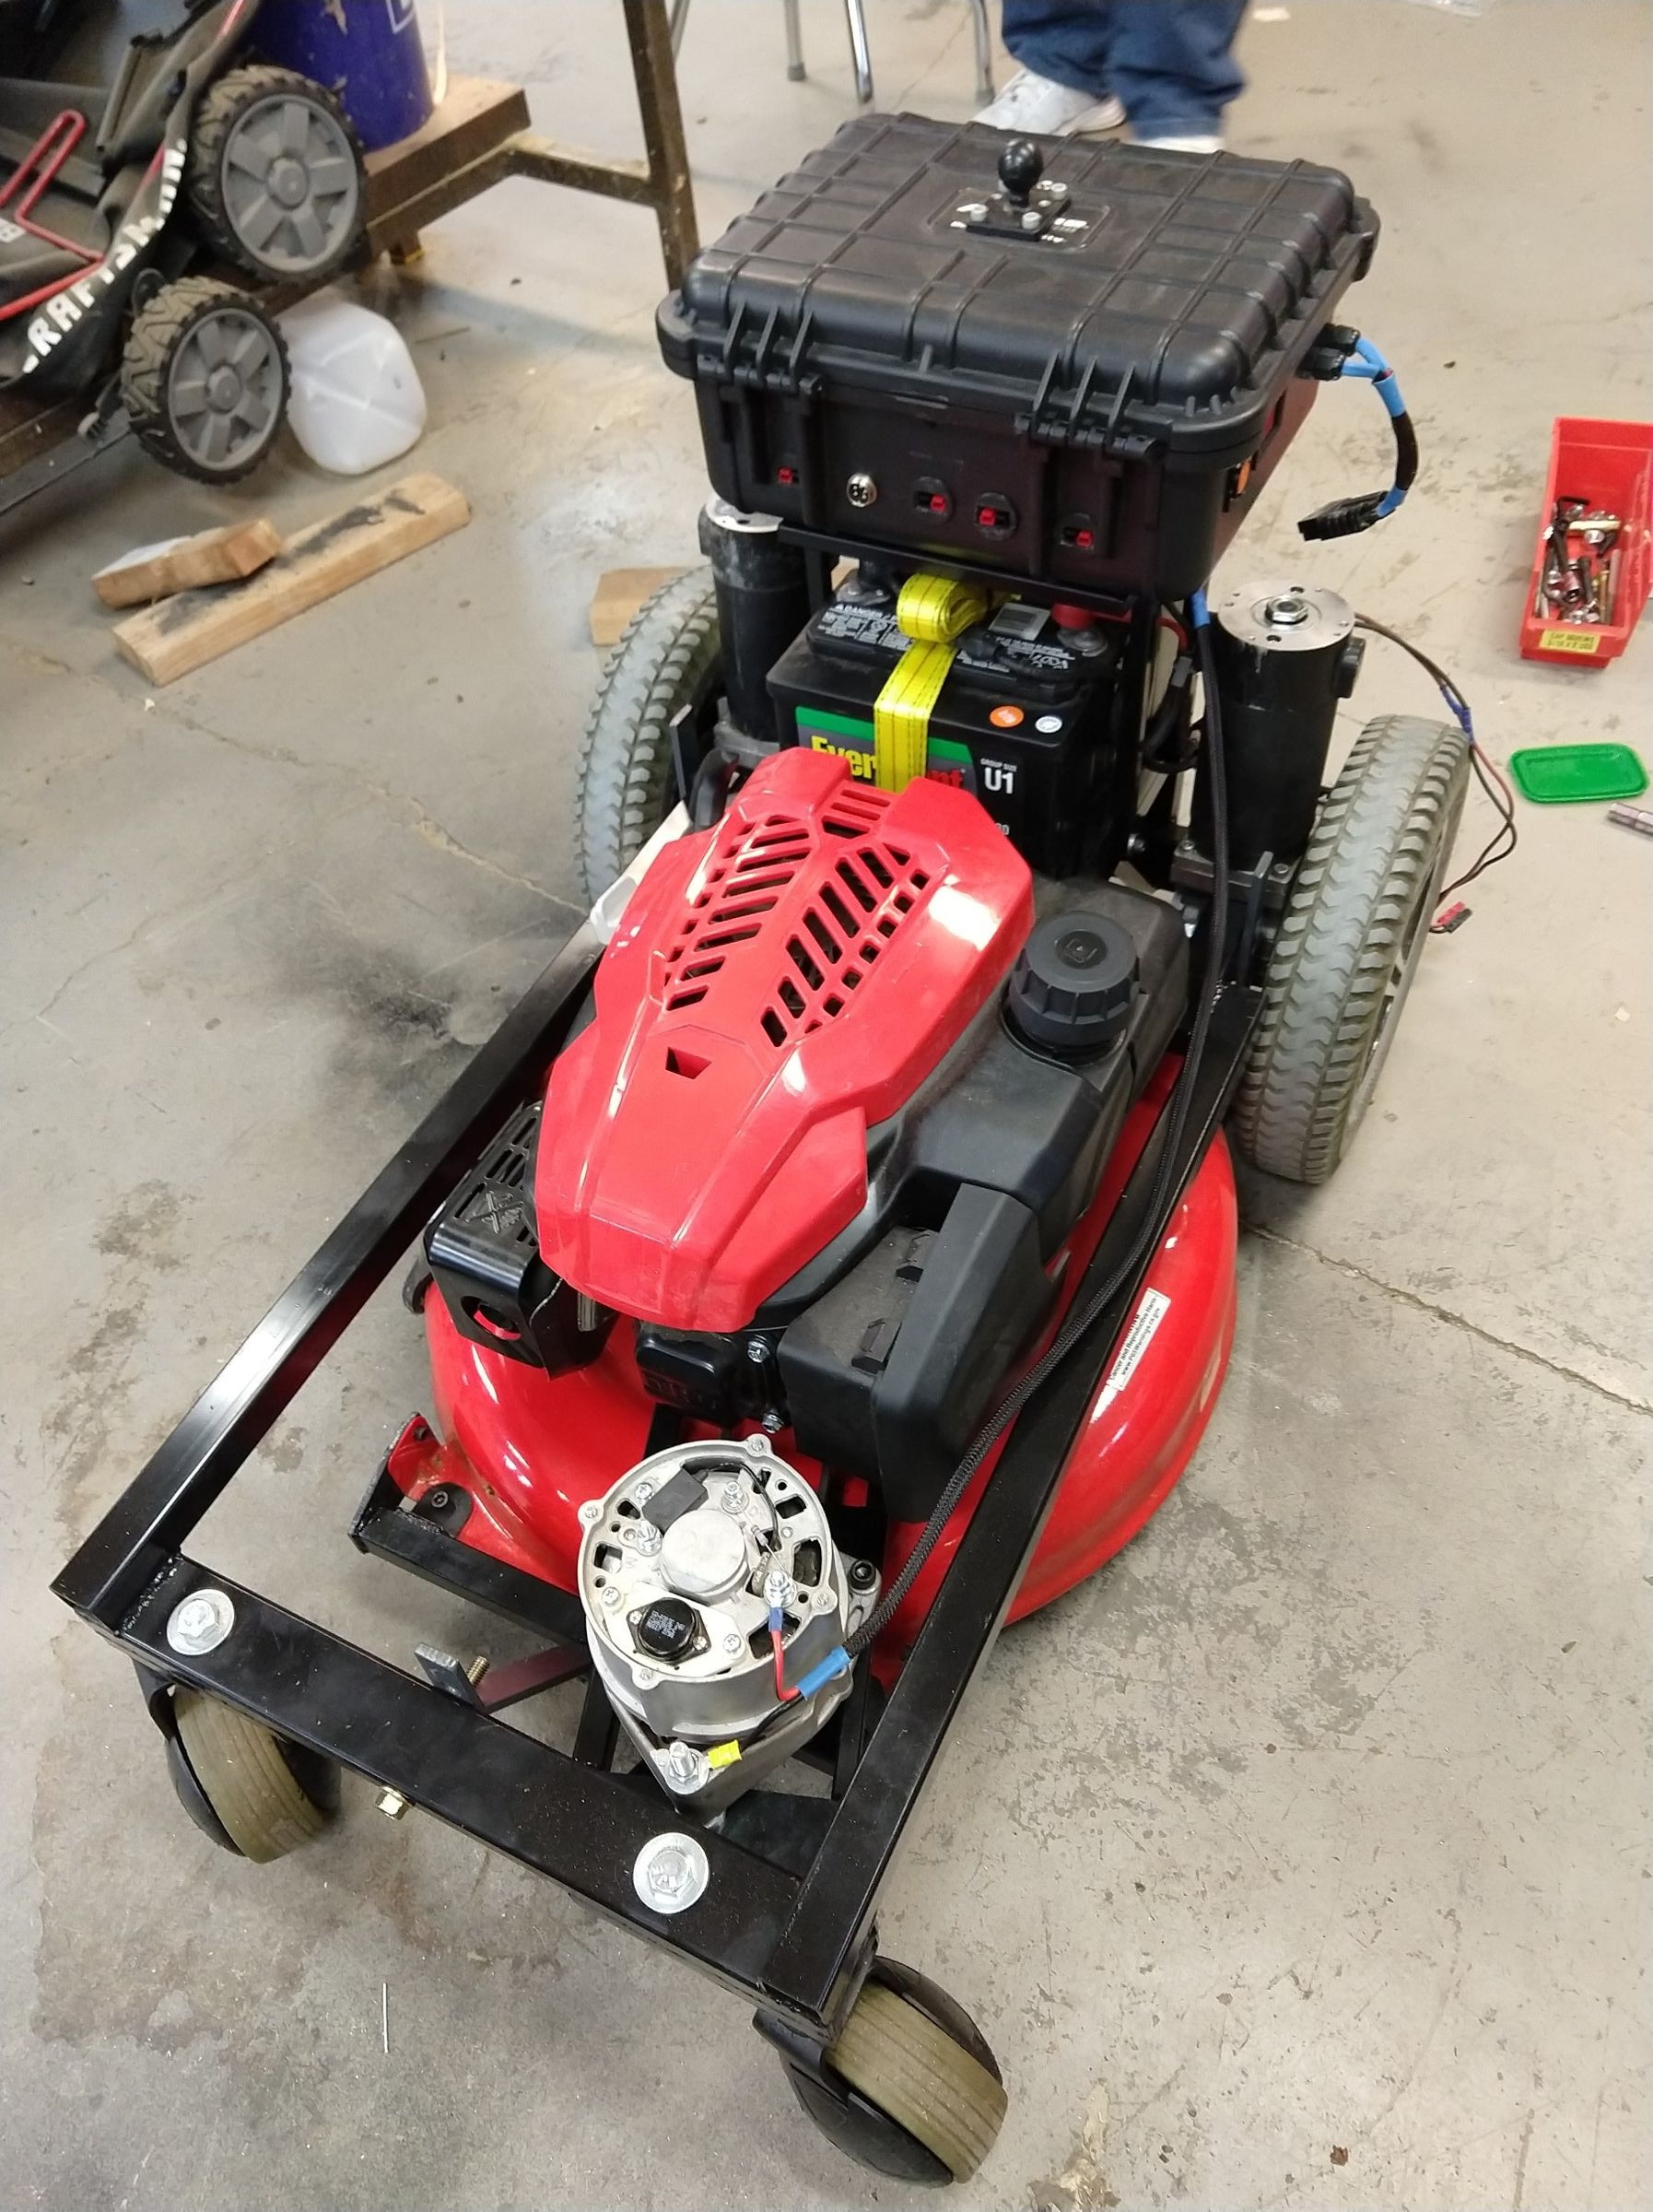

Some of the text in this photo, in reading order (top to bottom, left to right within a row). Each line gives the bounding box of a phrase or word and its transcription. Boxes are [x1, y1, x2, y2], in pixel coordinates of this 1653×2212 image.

[984, 767, 1014, 794] U1
[1120, 1348, 1129, 1359] and
[1126, 1312, 1148, 1348] Reproductive
[1145, 1298, 1156, 1312] Harm
